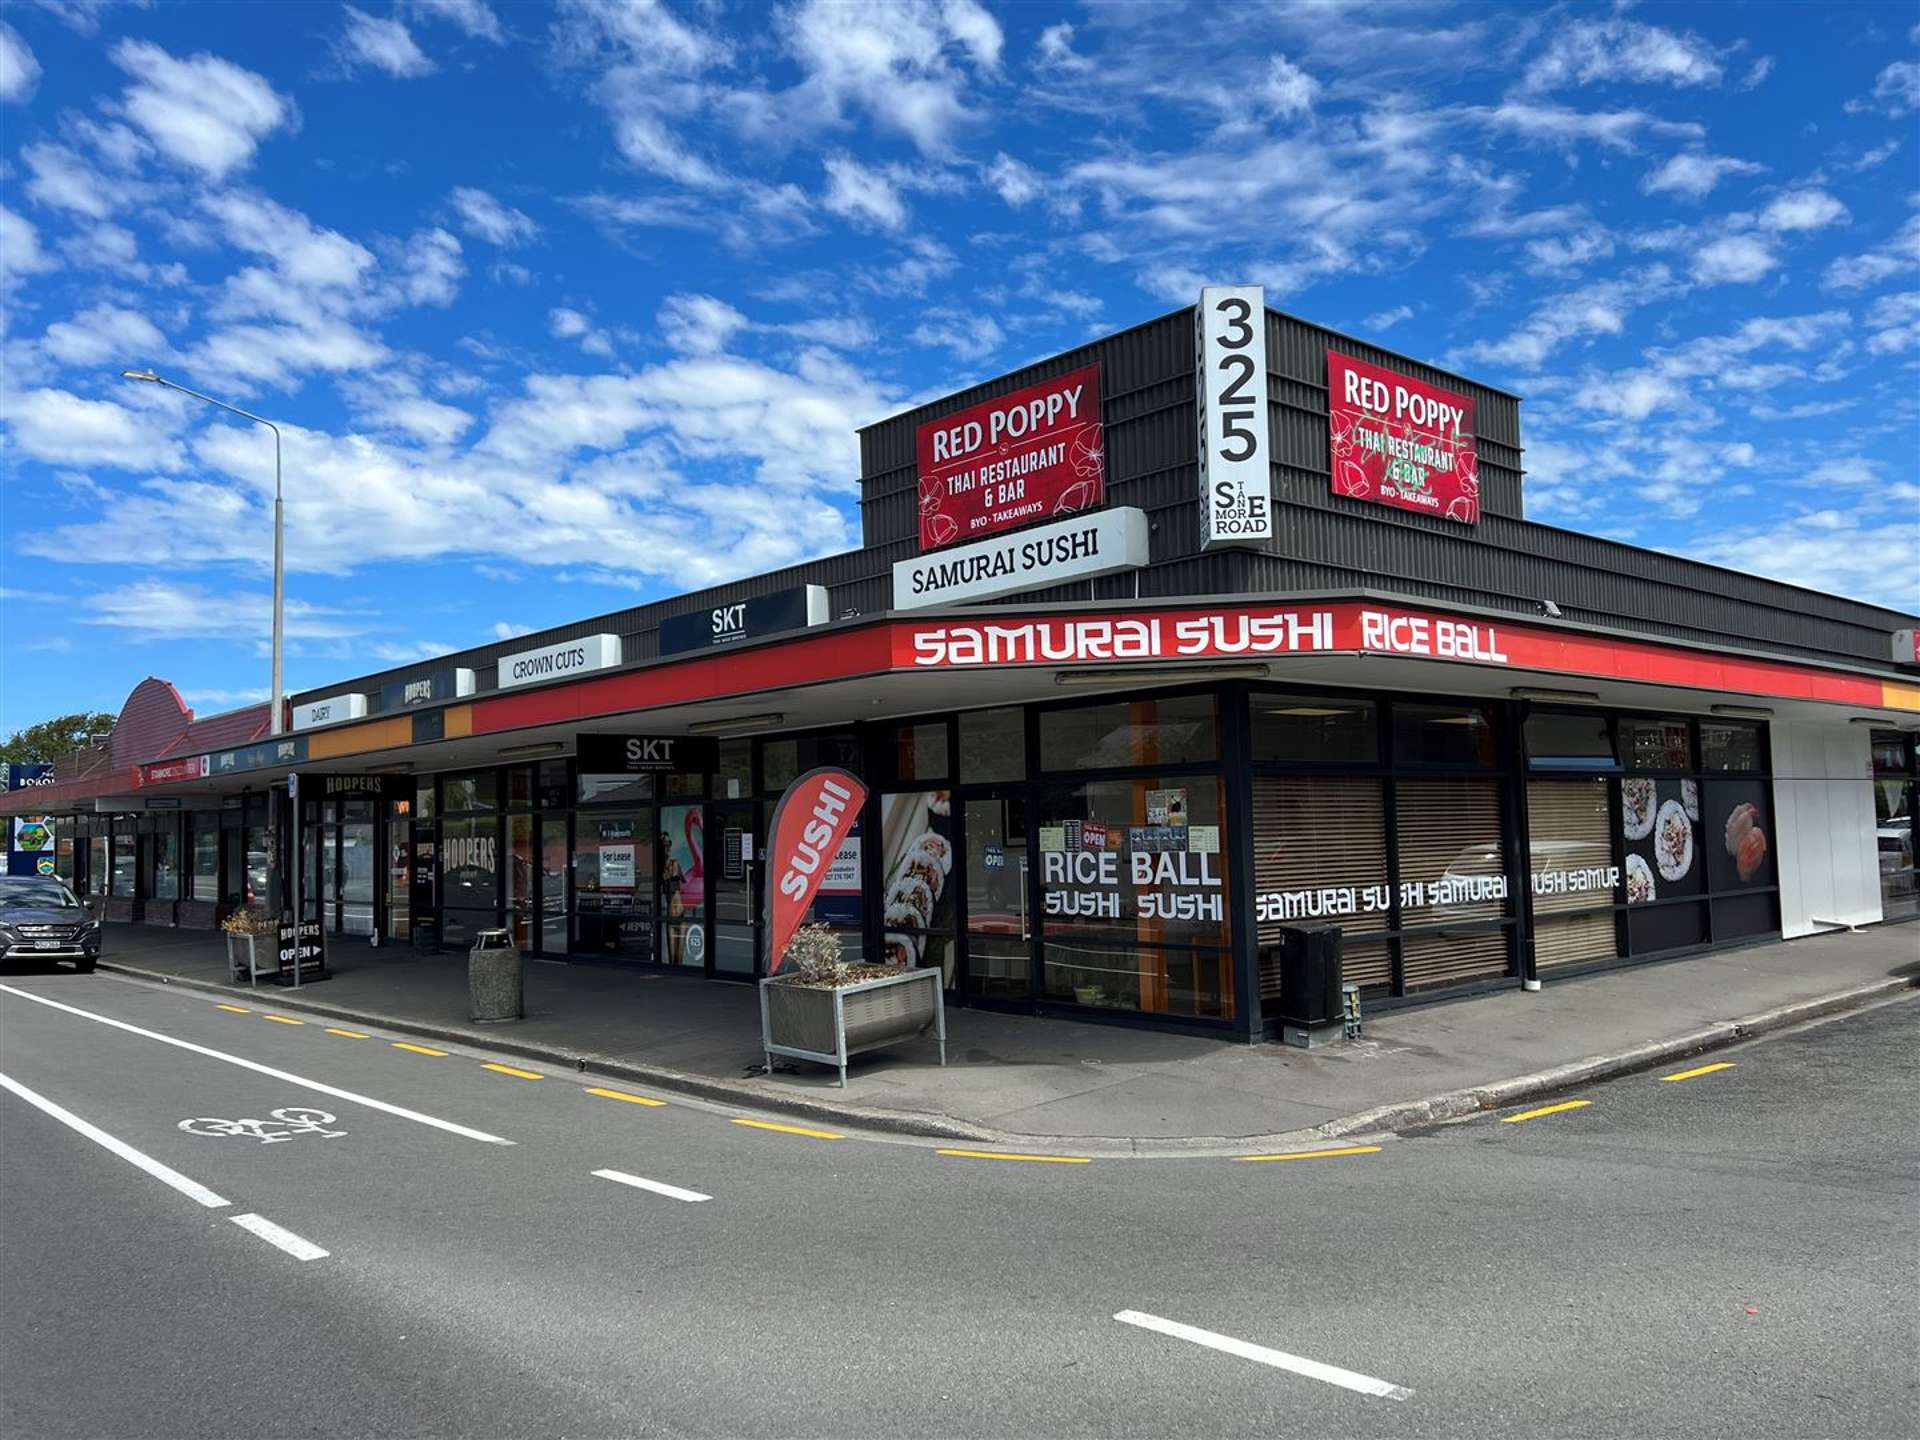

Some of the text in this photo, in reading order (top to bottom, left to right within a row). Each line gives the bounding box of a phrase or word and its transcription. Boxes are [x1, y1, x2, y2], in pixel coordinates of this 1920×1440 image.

[1344, 369, 1464, 436] RED POPPY
[933, 385, 1083, 463] RED POPPY
[1358, 427, 1455, 472] THAI RESTAURANT
[947, 443, 1066, 495] THAI RESTAURANT
[1403, 465, 1426, 487] BAR
[984, 479, 1025, 507] & BAR
[1380, 485, 1440, 508] BYO TAKEAWAYS
[970, 502, 1043, 529] BYO TAKEAWAYS
[1215, 519, 1267, 534] ROAD
[912, 527, 1099, 594] SAMURAI SUSHI
[712, 603, 746, 633] SKT
[913, 610, 1508, 666] SAMURAI SUSHI RICE BALL
[513, 648, 585, 680] CROWN CUTS
[404, 680, 432, 703] HOOPERS
[626, 738, 674, 760] SKT
[326, 776, 382, 794] HOOPERS
[443, 836, 496, 874] HOOPERS
[780, 779, 851, 902] SUSHI
[1083, 832, 1106, 848] OPEN
[602, 851, 631, 861] For Lease
[1044, 851, 1222, 886] RICE BALL
[1045, 890, 1224, 921] SUSHI SUSHI
[1255, 888, 1356, 922] SAMURAI
[1428, 875, 1508, 905] SAMURAI
[1569, 866, 1620, 888] SAMUR
[280, 945, 311, 961] OPEN
